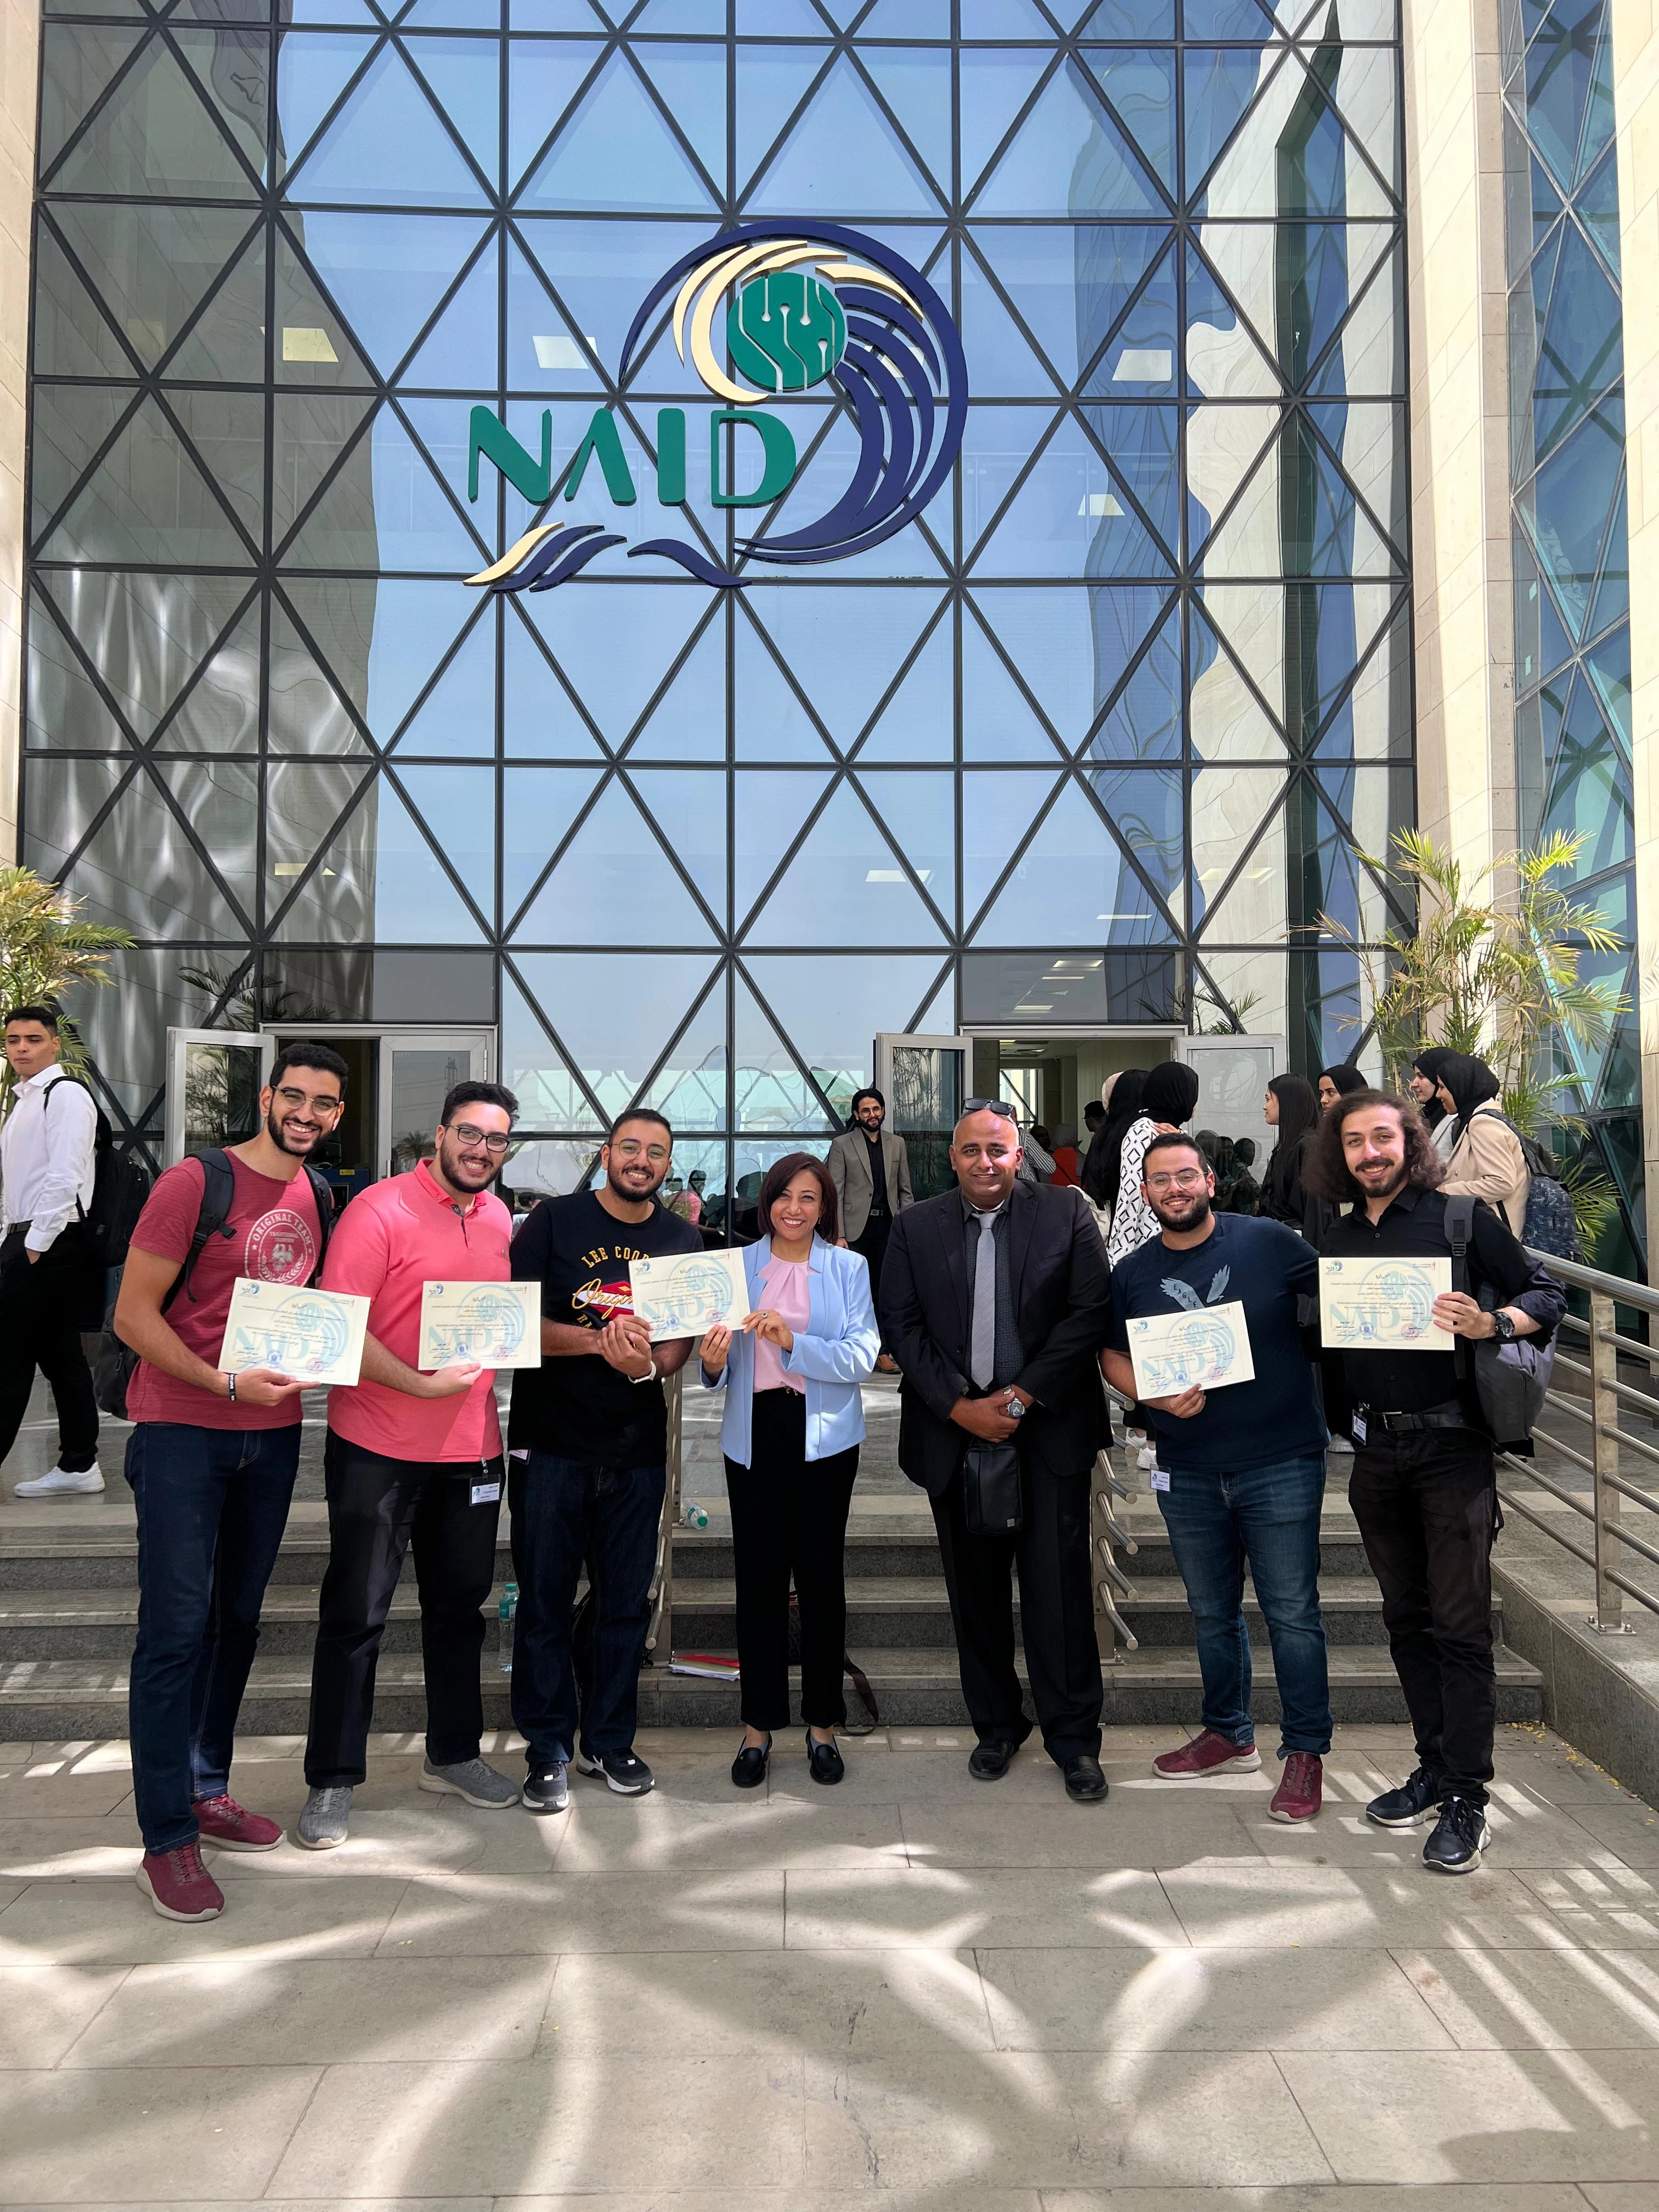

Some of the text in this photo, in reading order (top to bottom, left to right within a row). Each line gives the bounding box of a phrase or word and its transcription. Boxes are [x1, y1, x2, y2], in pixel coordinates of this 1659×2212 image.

[468, 405, 797, 507] NAID
[252, 1214, 312, 1244] ORIGINAL TEAM
[582, 1247, 608, 1268] LEE
[1173, 1284, 1197, 1308] EAGLE
